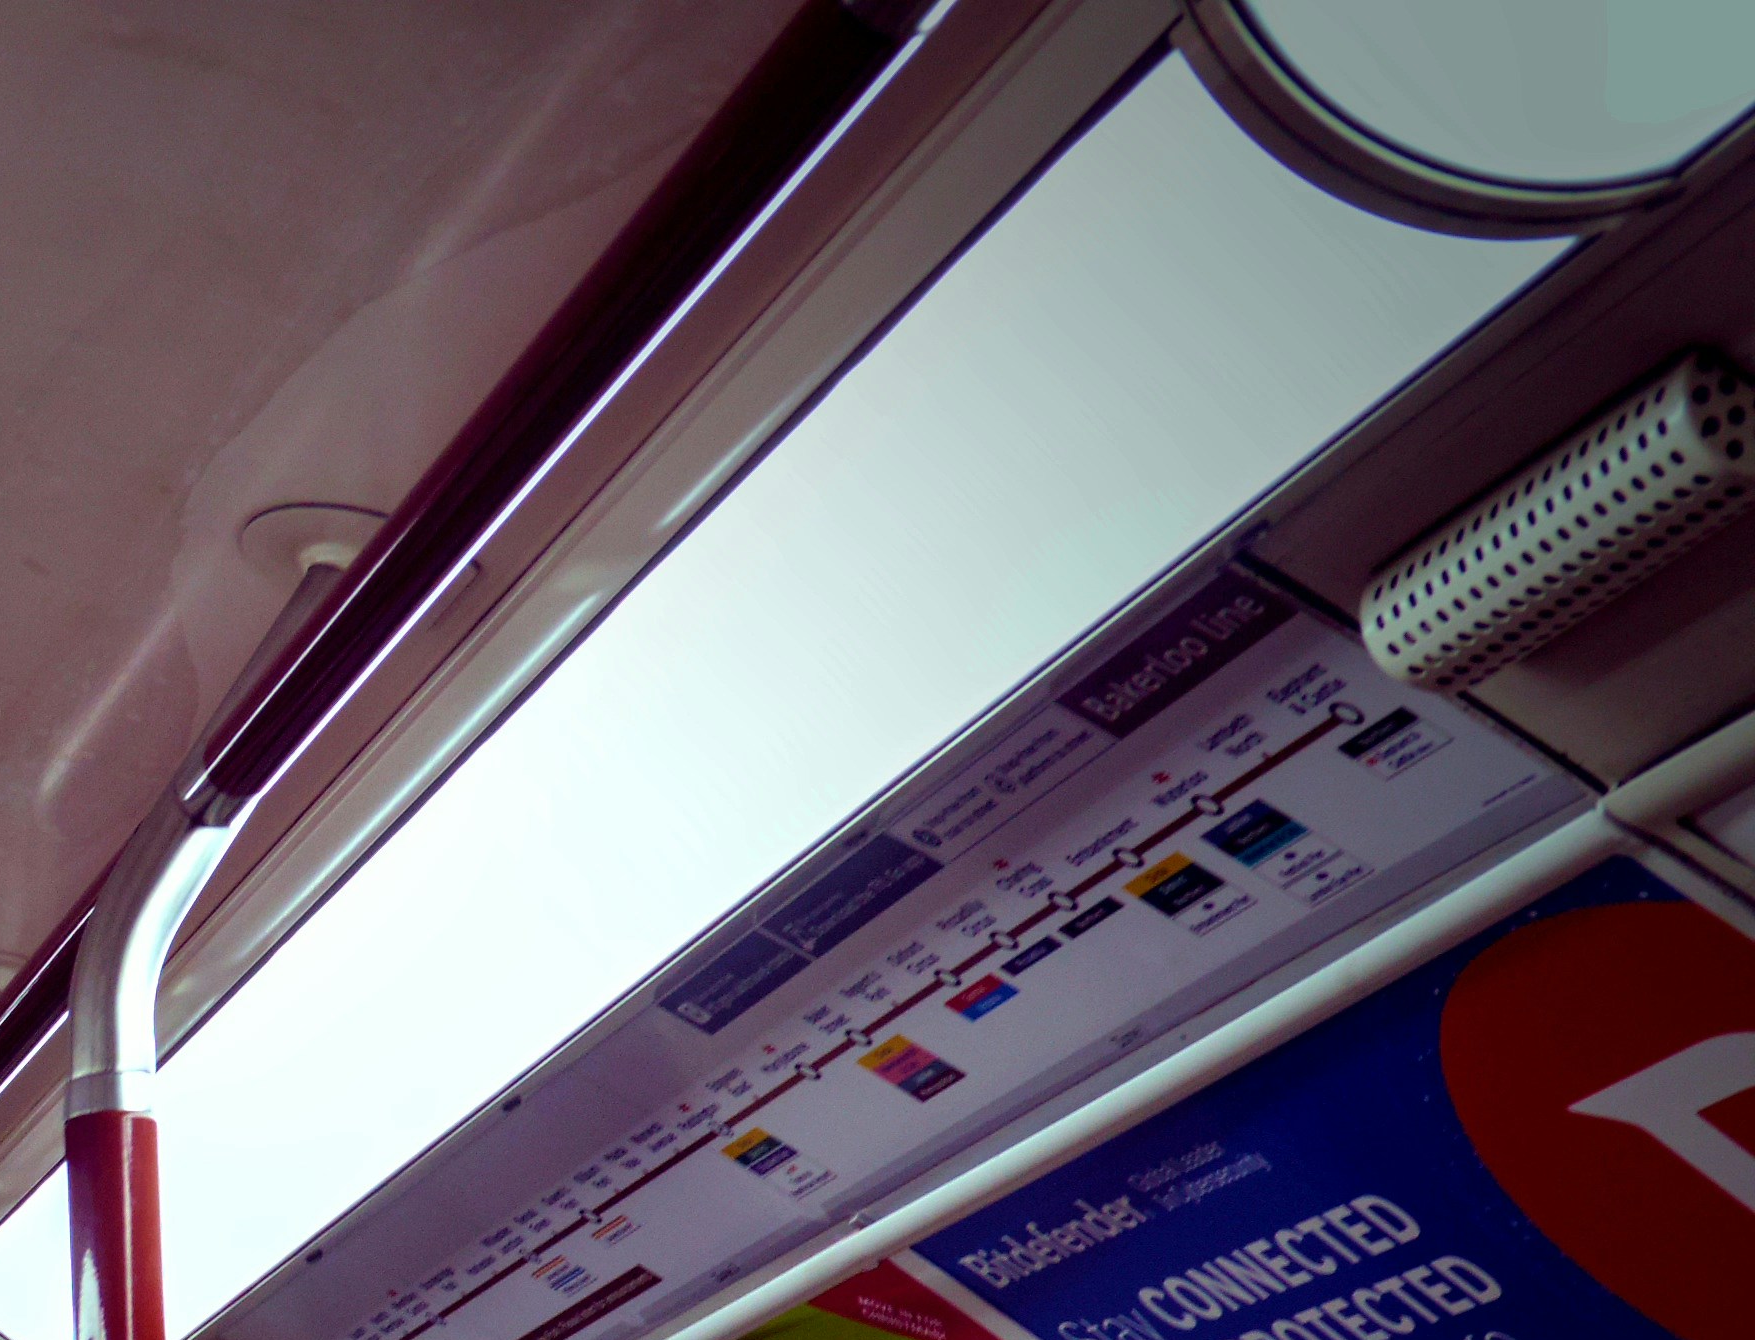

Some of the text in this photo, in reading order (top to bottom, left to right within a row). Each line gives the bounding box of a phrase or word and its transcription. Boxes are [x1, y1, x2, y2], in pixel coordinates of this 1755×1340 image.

[1082, 595, 1264, 720] Bakerloo line
[1138, 1193, 1423, 1331] CONNECTED
